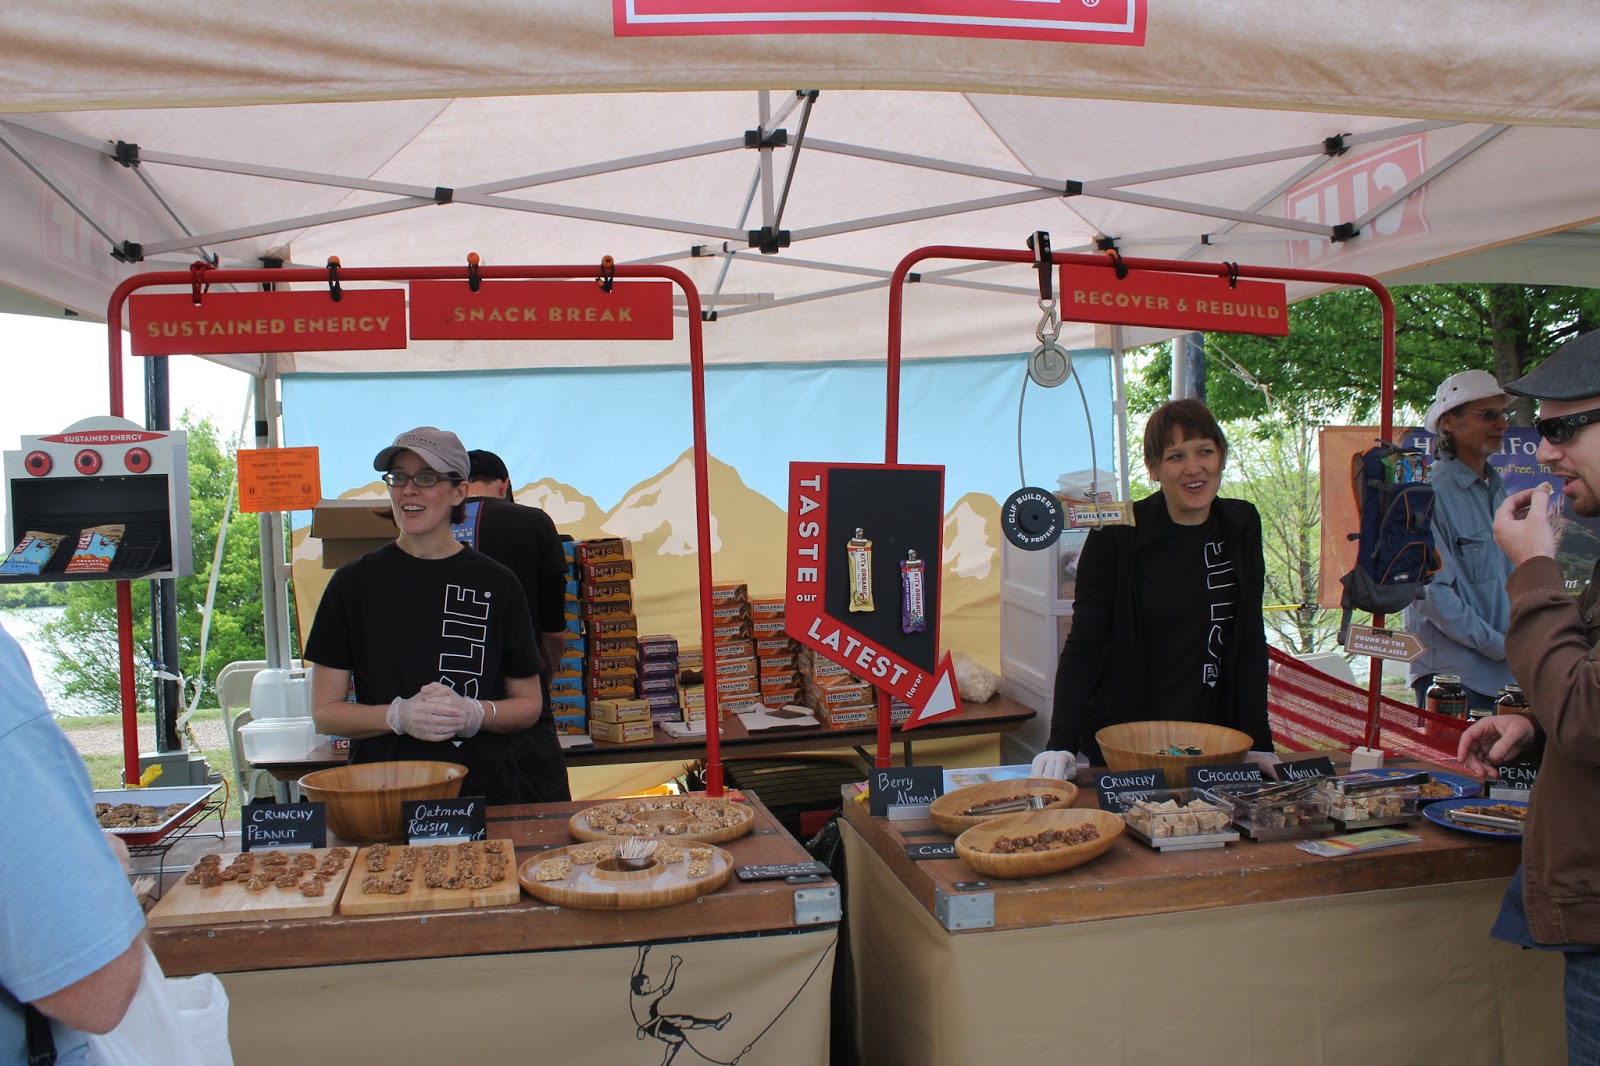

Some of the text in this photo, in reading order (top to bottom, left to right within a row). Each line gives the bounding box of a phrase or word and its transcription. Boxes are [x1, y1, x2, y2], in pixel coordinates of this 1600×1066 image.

[1073, 289, 1281, 320] RECOVER & REBUILD
[453, 306, 633, 322] SNACK BREAK
[146, 315, 391, 338] SUSTAINED ENERGY
[64, 433, 143, 444] SUSTAINED ENERGY
[1008, 493, 1056, 524] CLIF BUILDER'S
[796, 474, 821, 584] TASTE
[1016, 525, 1056, 544] 20g PROTEIN
[796, 593, 817, 602] our
[1355, 635, 1379, 643] FOUND
[807, 617, 908, 686] LATEST
[1354, 643, 1386, 653] GRANOLA
[906, 674, 923, 698] flavor
[1197, 769, 1262, 782] CHOCOLATE
[1284, 764, 1322, 780] VANILLA
[1498, 766, 1537, 780] PEAN
[878, 773, 913, 791] Berry
[1100, 774, 1155, 789] CRUNCHY
[896, 788, 937, 804] Almond
[252, 809, 314, 822] CRUNCHY
[415, 803, 474, 820] Oatmeal
[246, 825, 297, 841] PEANUT
[408, 819, 448, 835] Raisin
